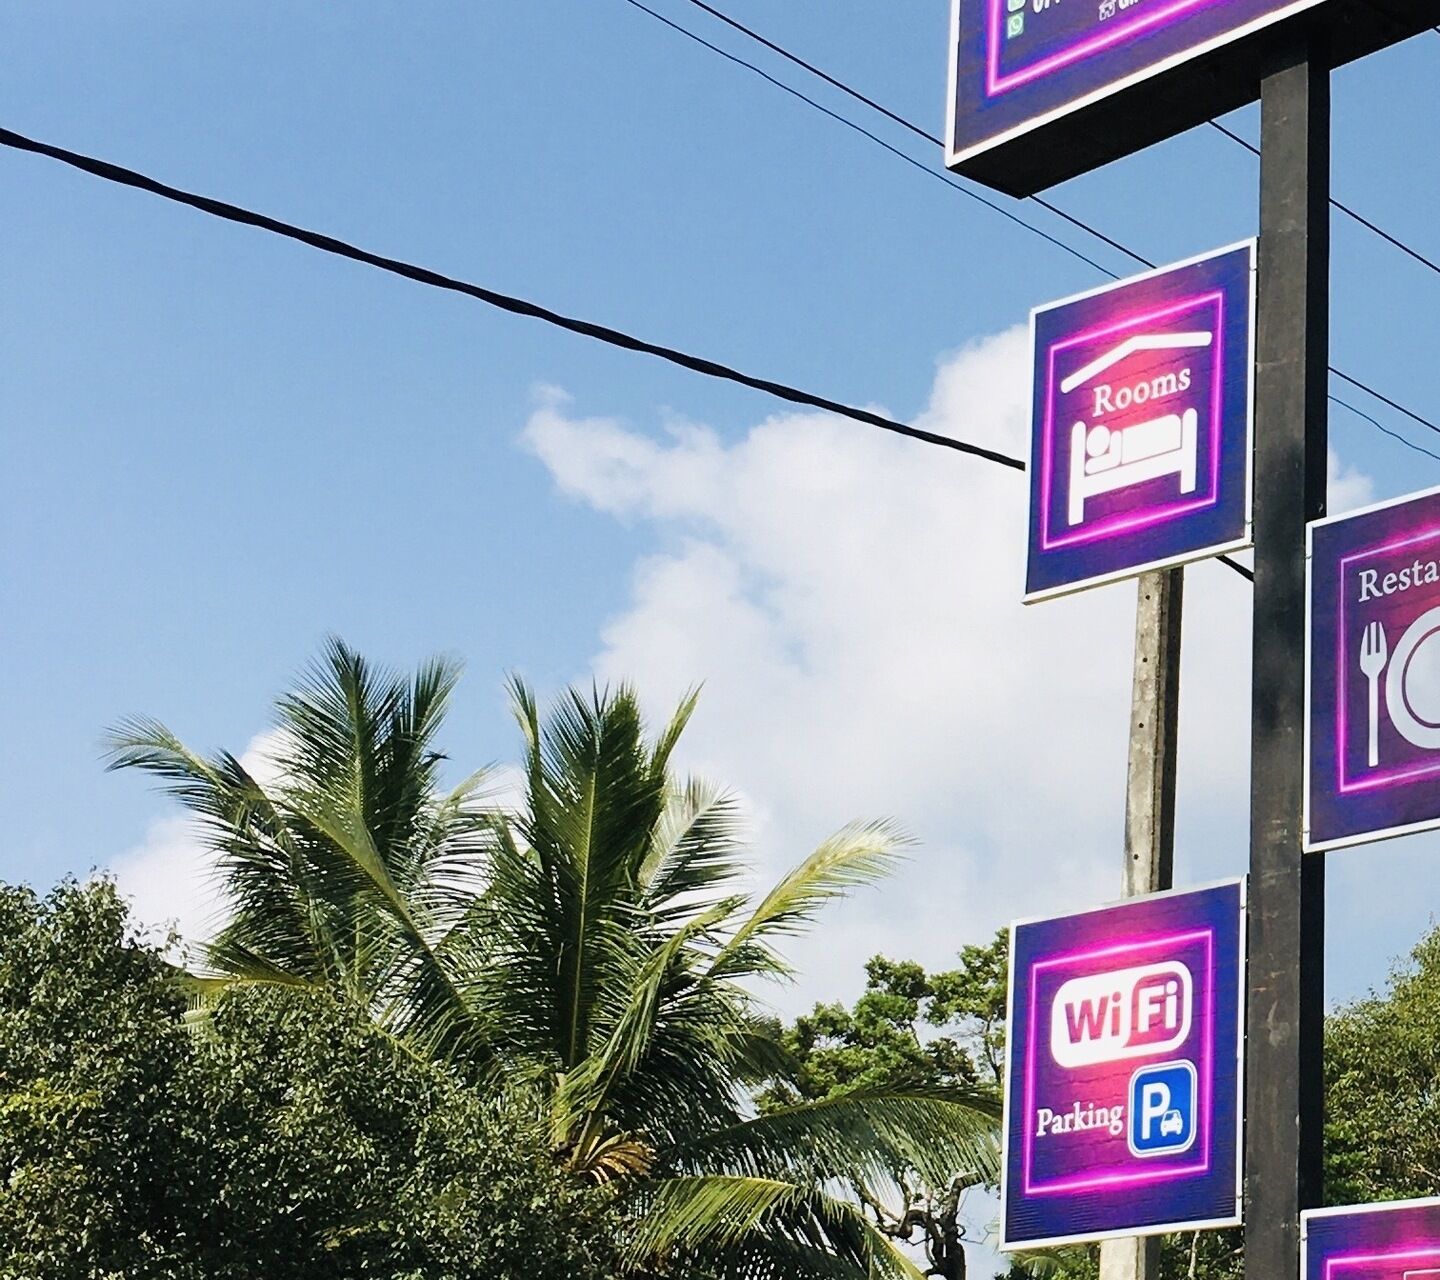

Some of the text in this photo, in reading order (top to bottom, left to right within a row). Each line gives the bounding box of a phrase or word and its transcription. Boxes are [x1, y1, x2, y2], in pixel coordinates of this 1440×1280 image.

[1092, 367, 1192, 418] Rooms
[1036, 1101, 1124, 1137] Parking
[1141, 1082, 1171, 1140] P
